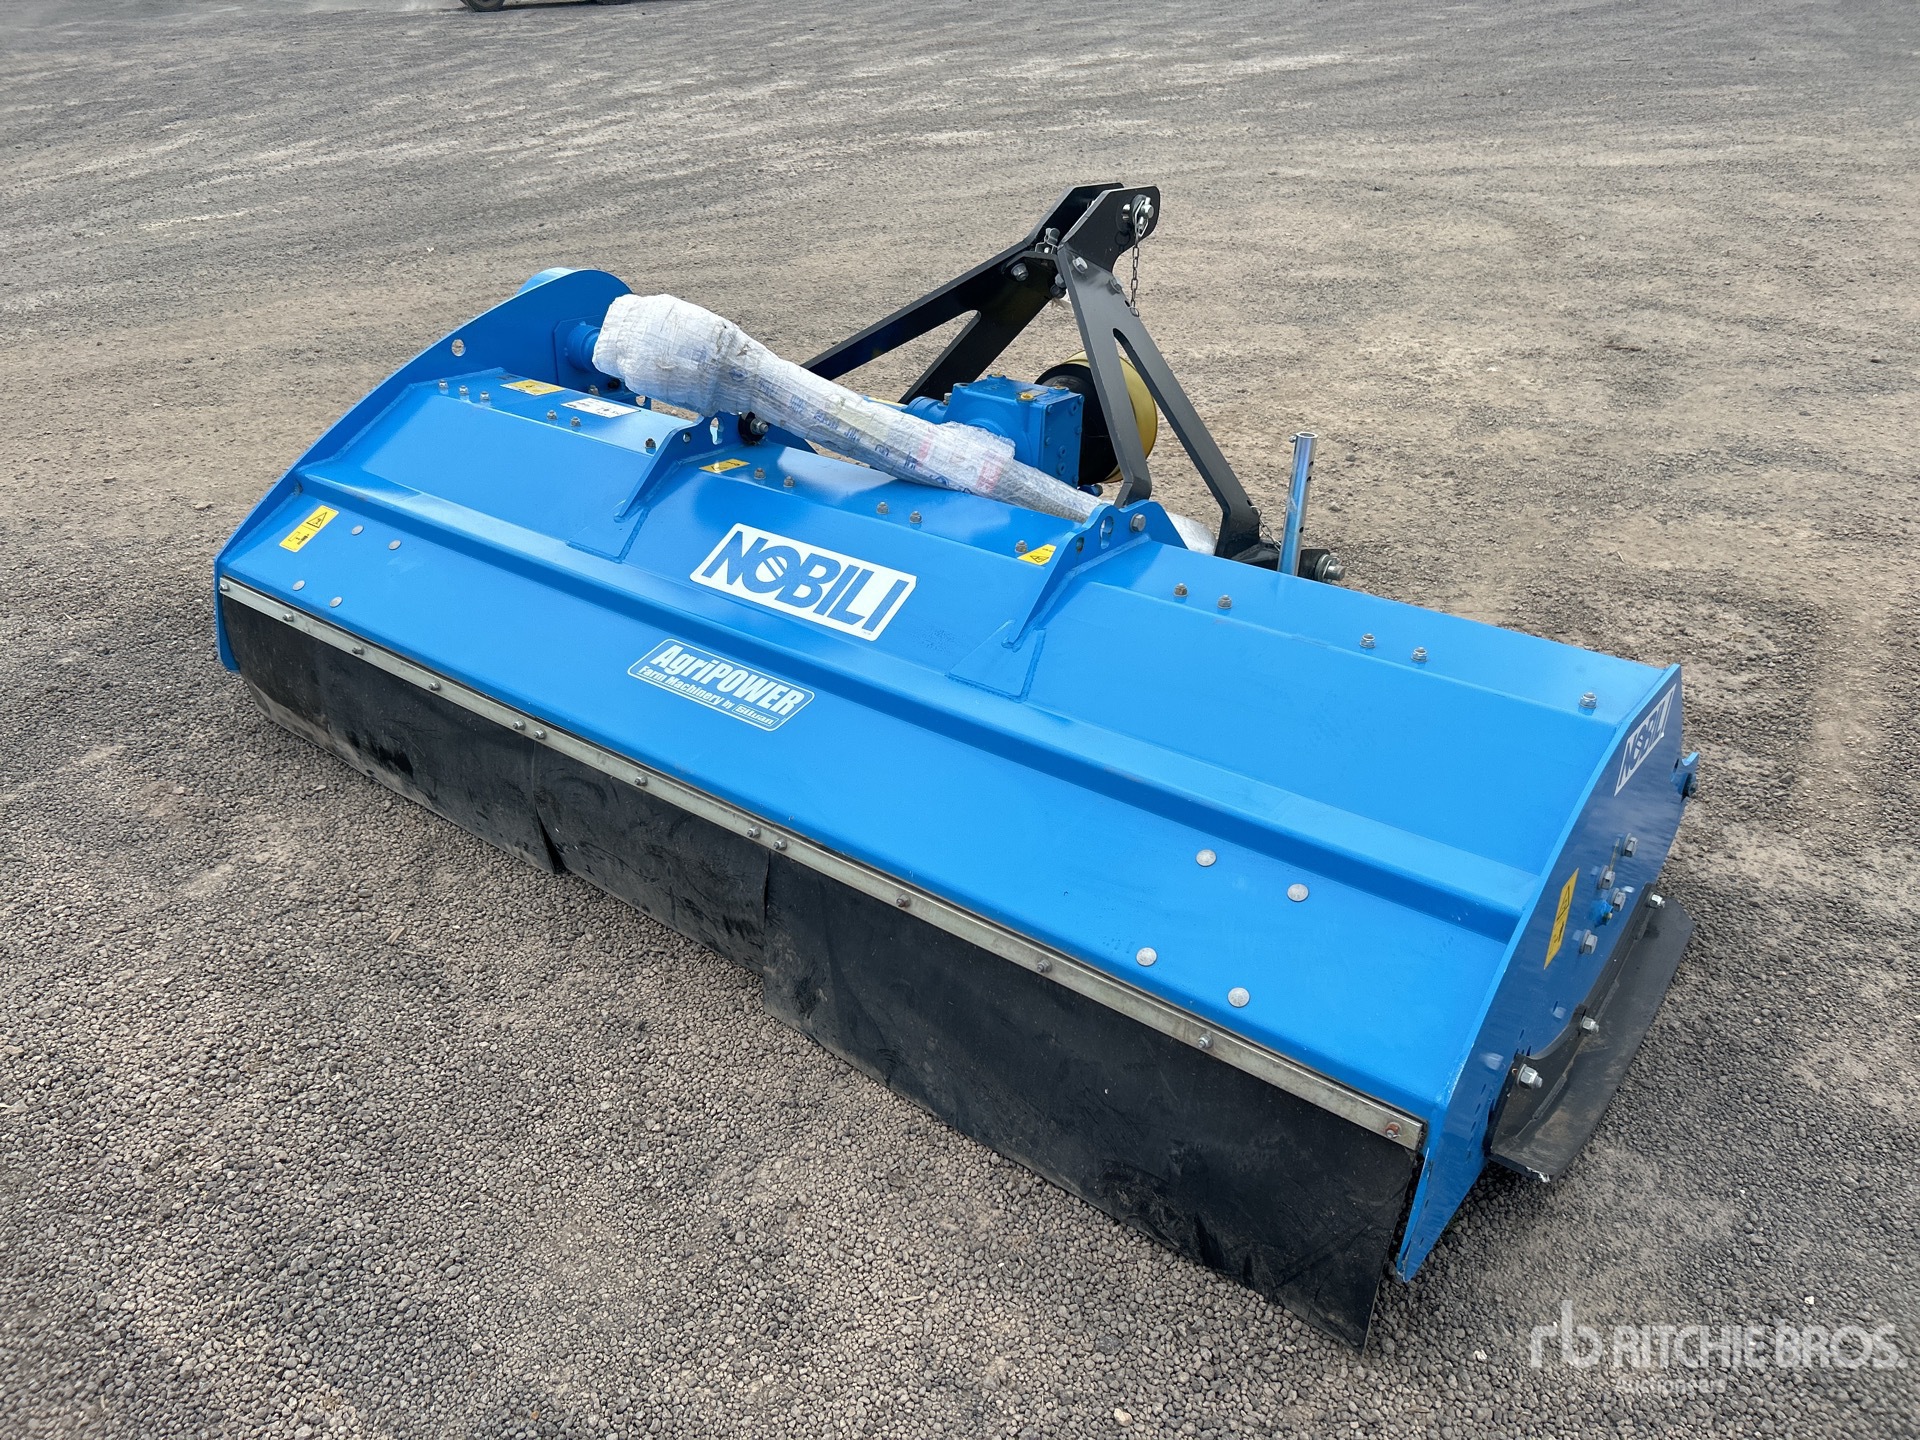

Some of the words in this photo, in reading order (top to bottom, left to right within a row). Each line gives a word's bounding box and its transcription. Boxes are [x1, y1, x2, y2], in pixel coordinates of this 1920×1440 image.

[701, 531, 909, 632] NOBILI
[637, 665, 667, 682] Farm
[665, 676, 724, 706] Machinery
[722, 700, 734, 710] by
[650, 645, 805, 716] AgriPOWER
[1618, 690, 1674, 788] NOBILI
